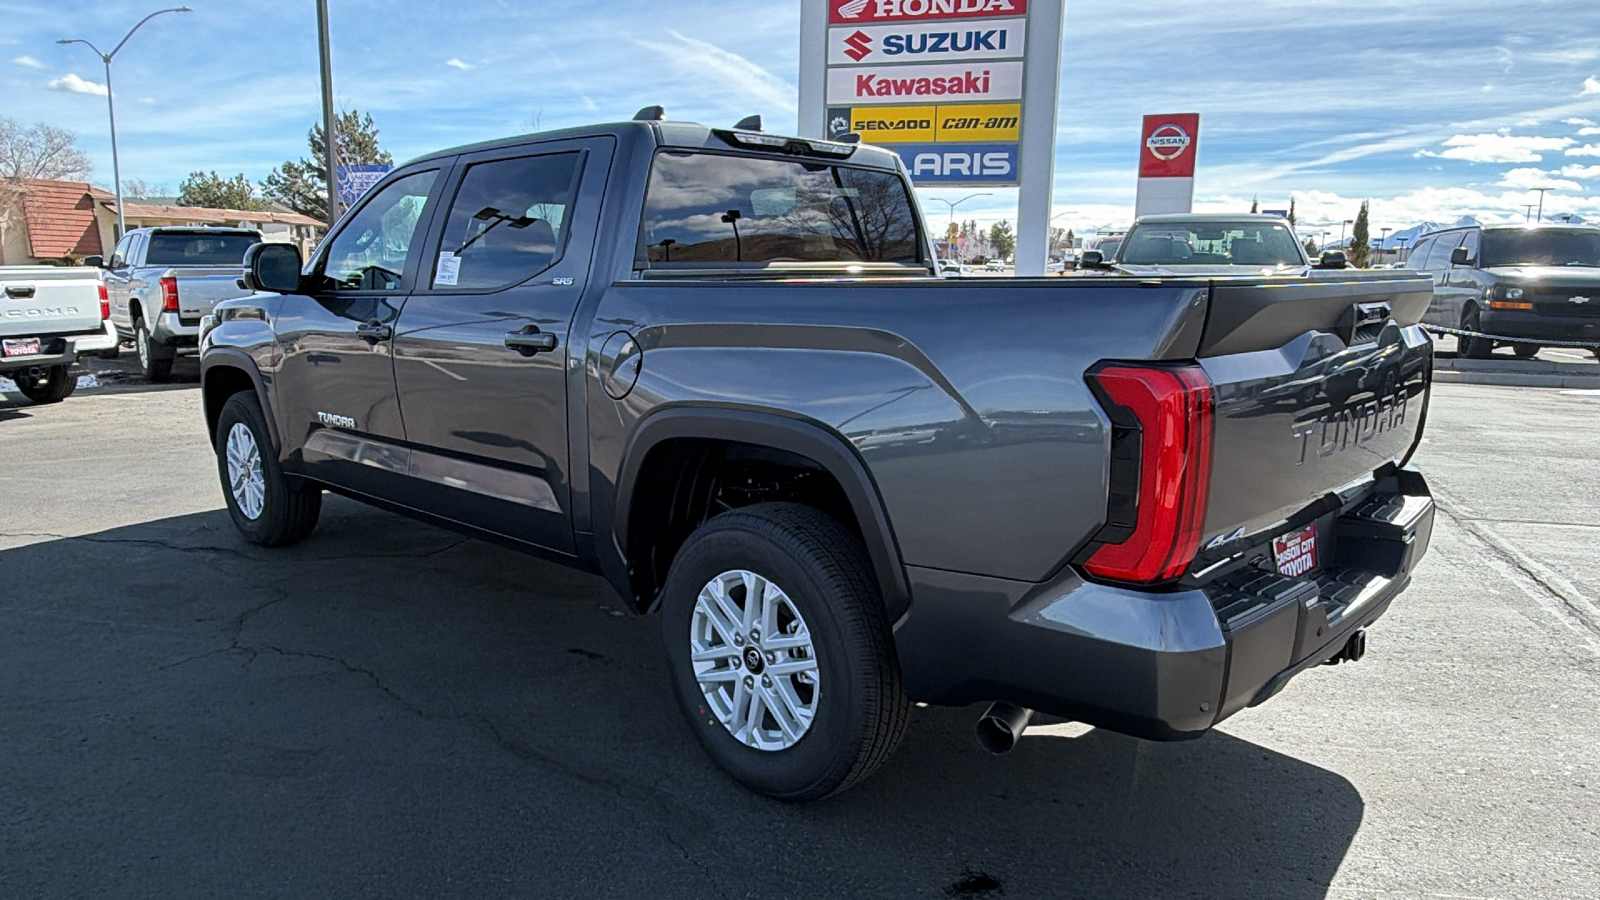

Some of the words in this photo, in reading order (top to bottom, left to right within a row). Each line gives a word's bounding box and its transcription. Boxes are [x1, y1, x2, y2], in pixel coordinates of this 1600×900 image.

[874, 0, 1015, 17] HONDA
[882, 29, 1008, 56] SUZUKI
[856, 70, 990, 97] Kawasaki
[941, 116, 1017, 130] can-am
[552, 277, 574, 285] SR5
[0, 306, 79, 318] COMA
[9, 346, 37, 356] TOYOTA
[317, 411, 356, 429] TUNDRA
[1291, 388, 1408, 466] TUNDRA
[1301, 536, 1315, 554] CITY
[1280, 552, 1313, 577] TOYOTA
